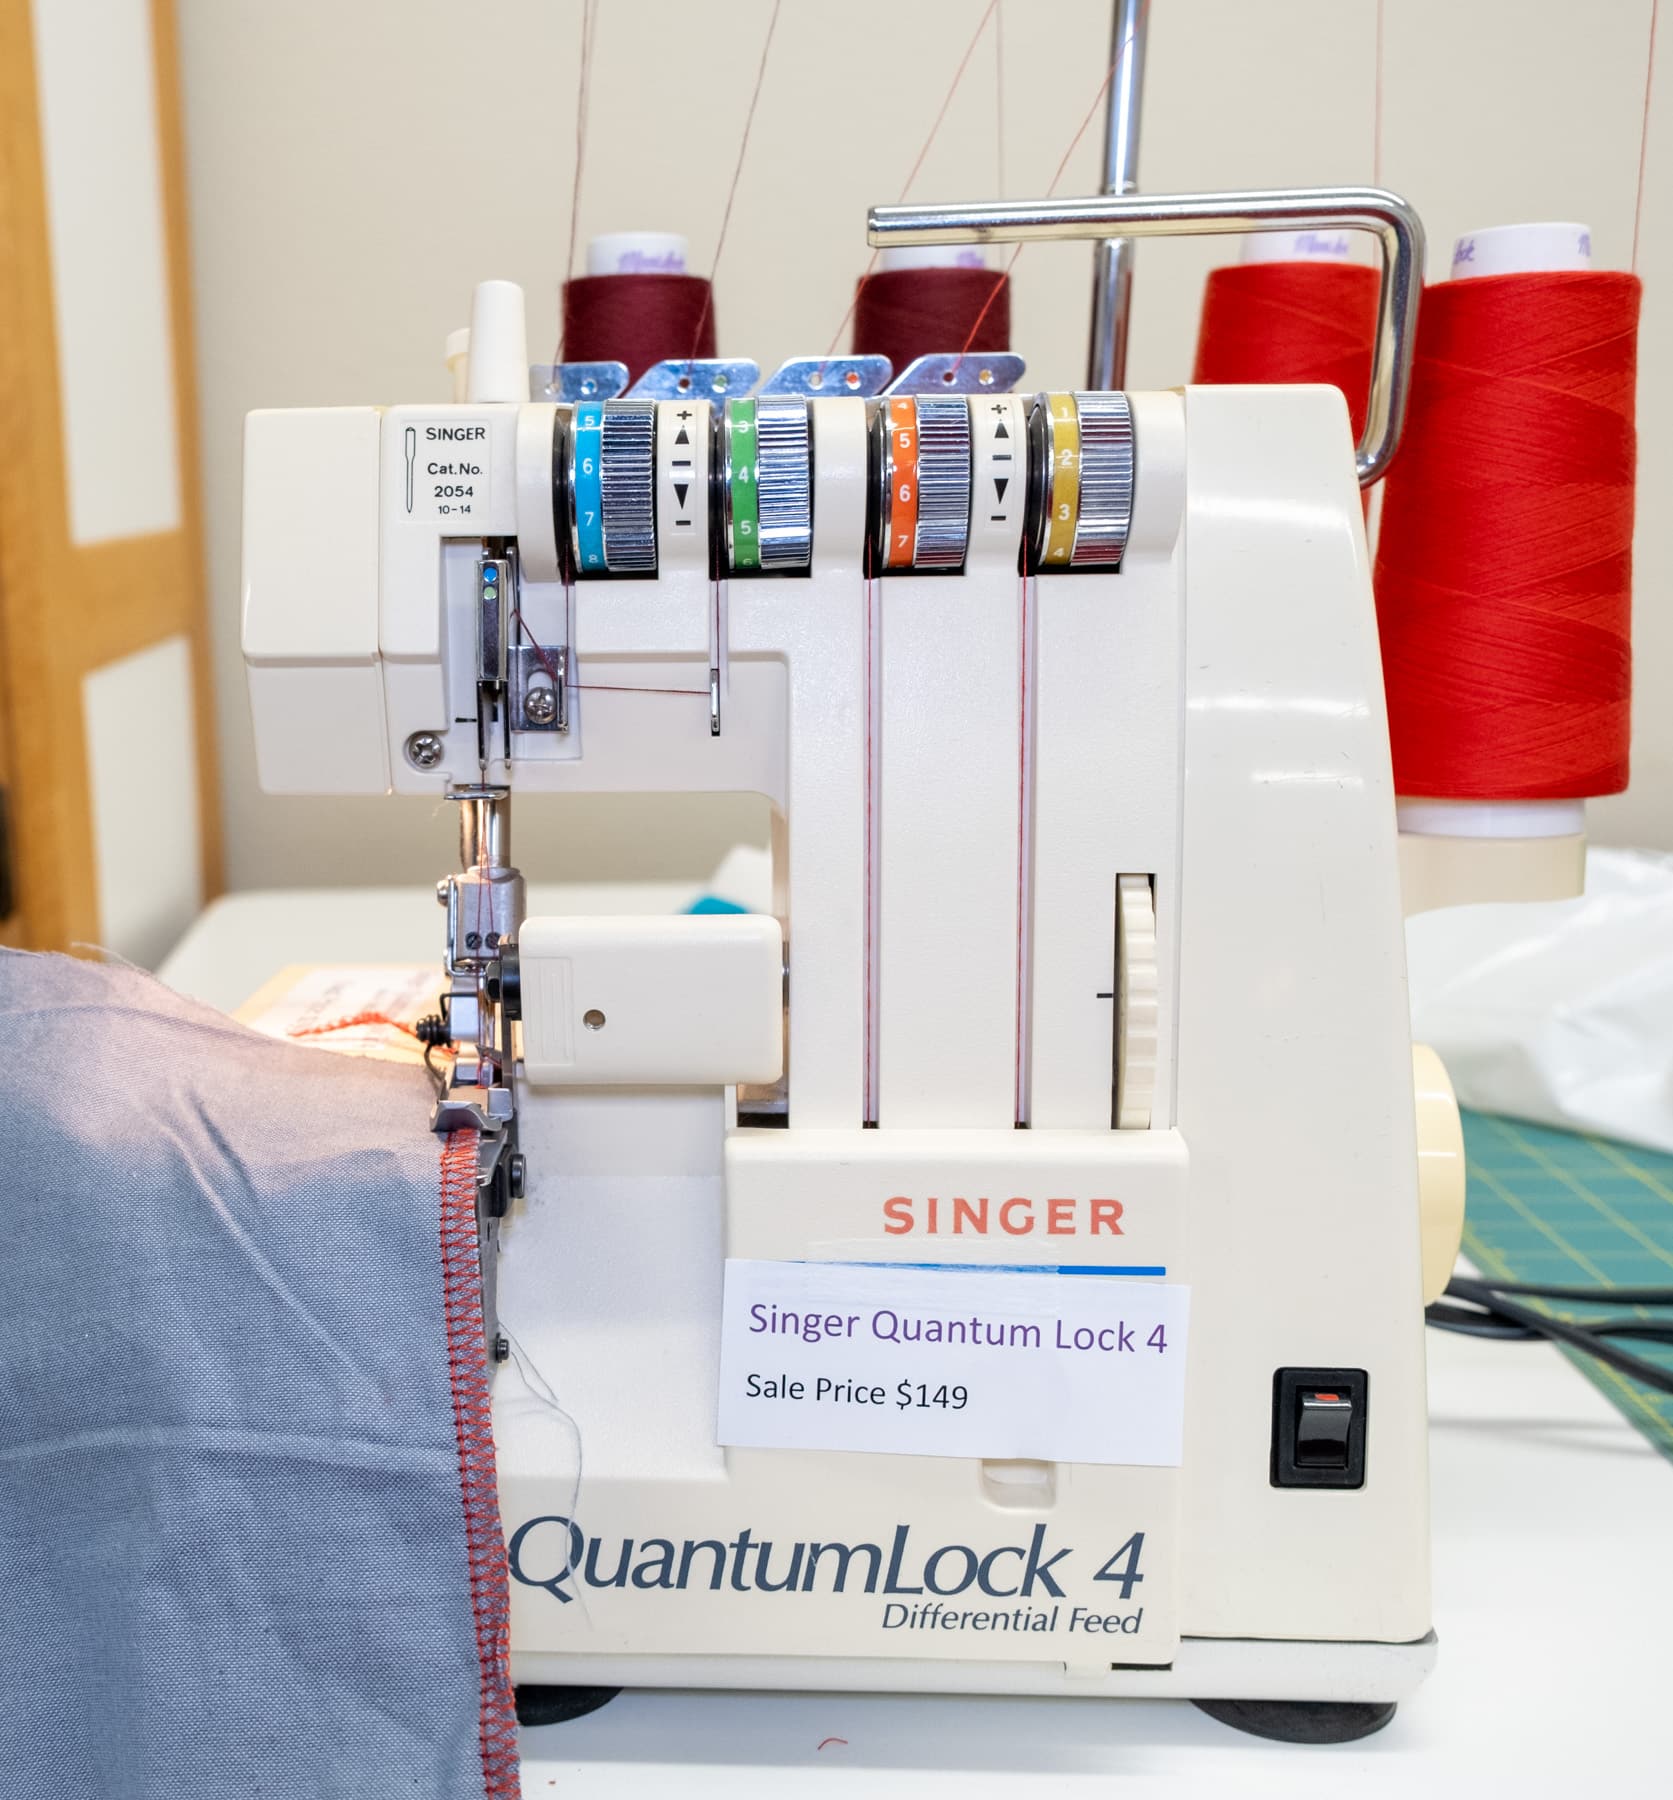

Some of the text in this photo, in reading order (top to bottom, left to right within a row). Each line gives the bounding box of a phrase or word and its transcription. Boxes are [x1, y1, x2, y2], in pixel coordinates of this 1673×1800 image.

[1061, 407, 1068, 418] 1
[584, 415, 594, 427] 5
[738, 420, 748, 433] 3
[425, 426, 486, 441] SINGER
[899, 433, 910, 448] 5
[1061, 449, 1073, 465] 2
[582, 458, 593, 474] 6
[738, 466, 749, 484] 4
[434, 485, 474, 498] 2054
[899, 485, 911, 502] 6
[584, 511, 594, 527] 7
[1058, 504, 1070, 521] 3
[740, 521, 751, 535] 5
[898, 535, 908, 547] 7
[588, 554, 598, 564] 8
[1053, 547, 1064, 558] 4
[883, 1196, 1125, 1236] SINGER
[748, 1303, 1168, 1354] Singer Quantum Lock 4
[746, 1373, 969, 1411] Sale Price $149
[508, 1515, 1146, 1604] QuantumLock 4
[882, 1602, 1144, 1634] Differential Feed
